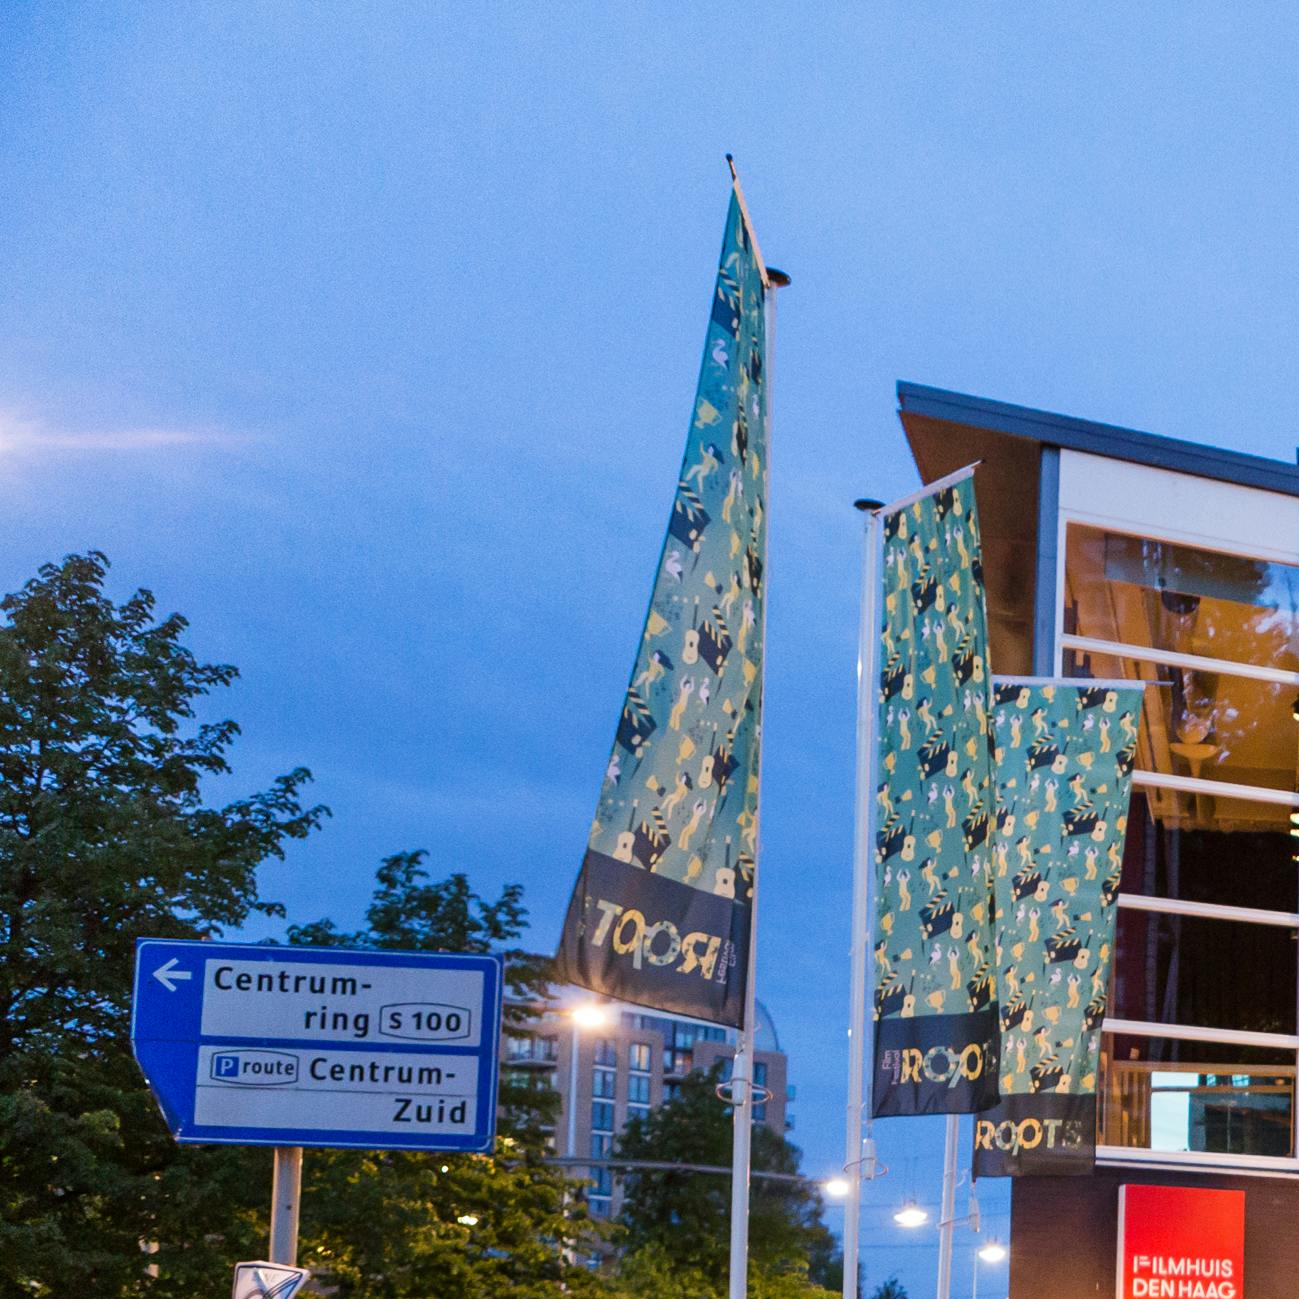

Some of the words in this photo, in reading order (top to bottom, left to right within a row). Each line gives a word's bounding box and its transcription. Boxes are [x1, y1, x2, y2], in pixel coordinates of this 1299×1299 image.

[214, 966, 372, 995] Centrum-
[304, 1005, 370, 1038] ring
[389, 1011, 403, 1030] S
[412, 1012, 461, 1032] 100
[220, 1060, 234, 1075] P
[242, 1059, 295, 1076] route
[309, 1057, 456, 1085] Centrum-
[393, 1098, 466, 1124] Zuid
[1133, 1255, 1233, 1278] FILMHUIS
[1133, 1278, 1175, 1298] DEN
[1178, 1280, 1237, 1299] HAAG
